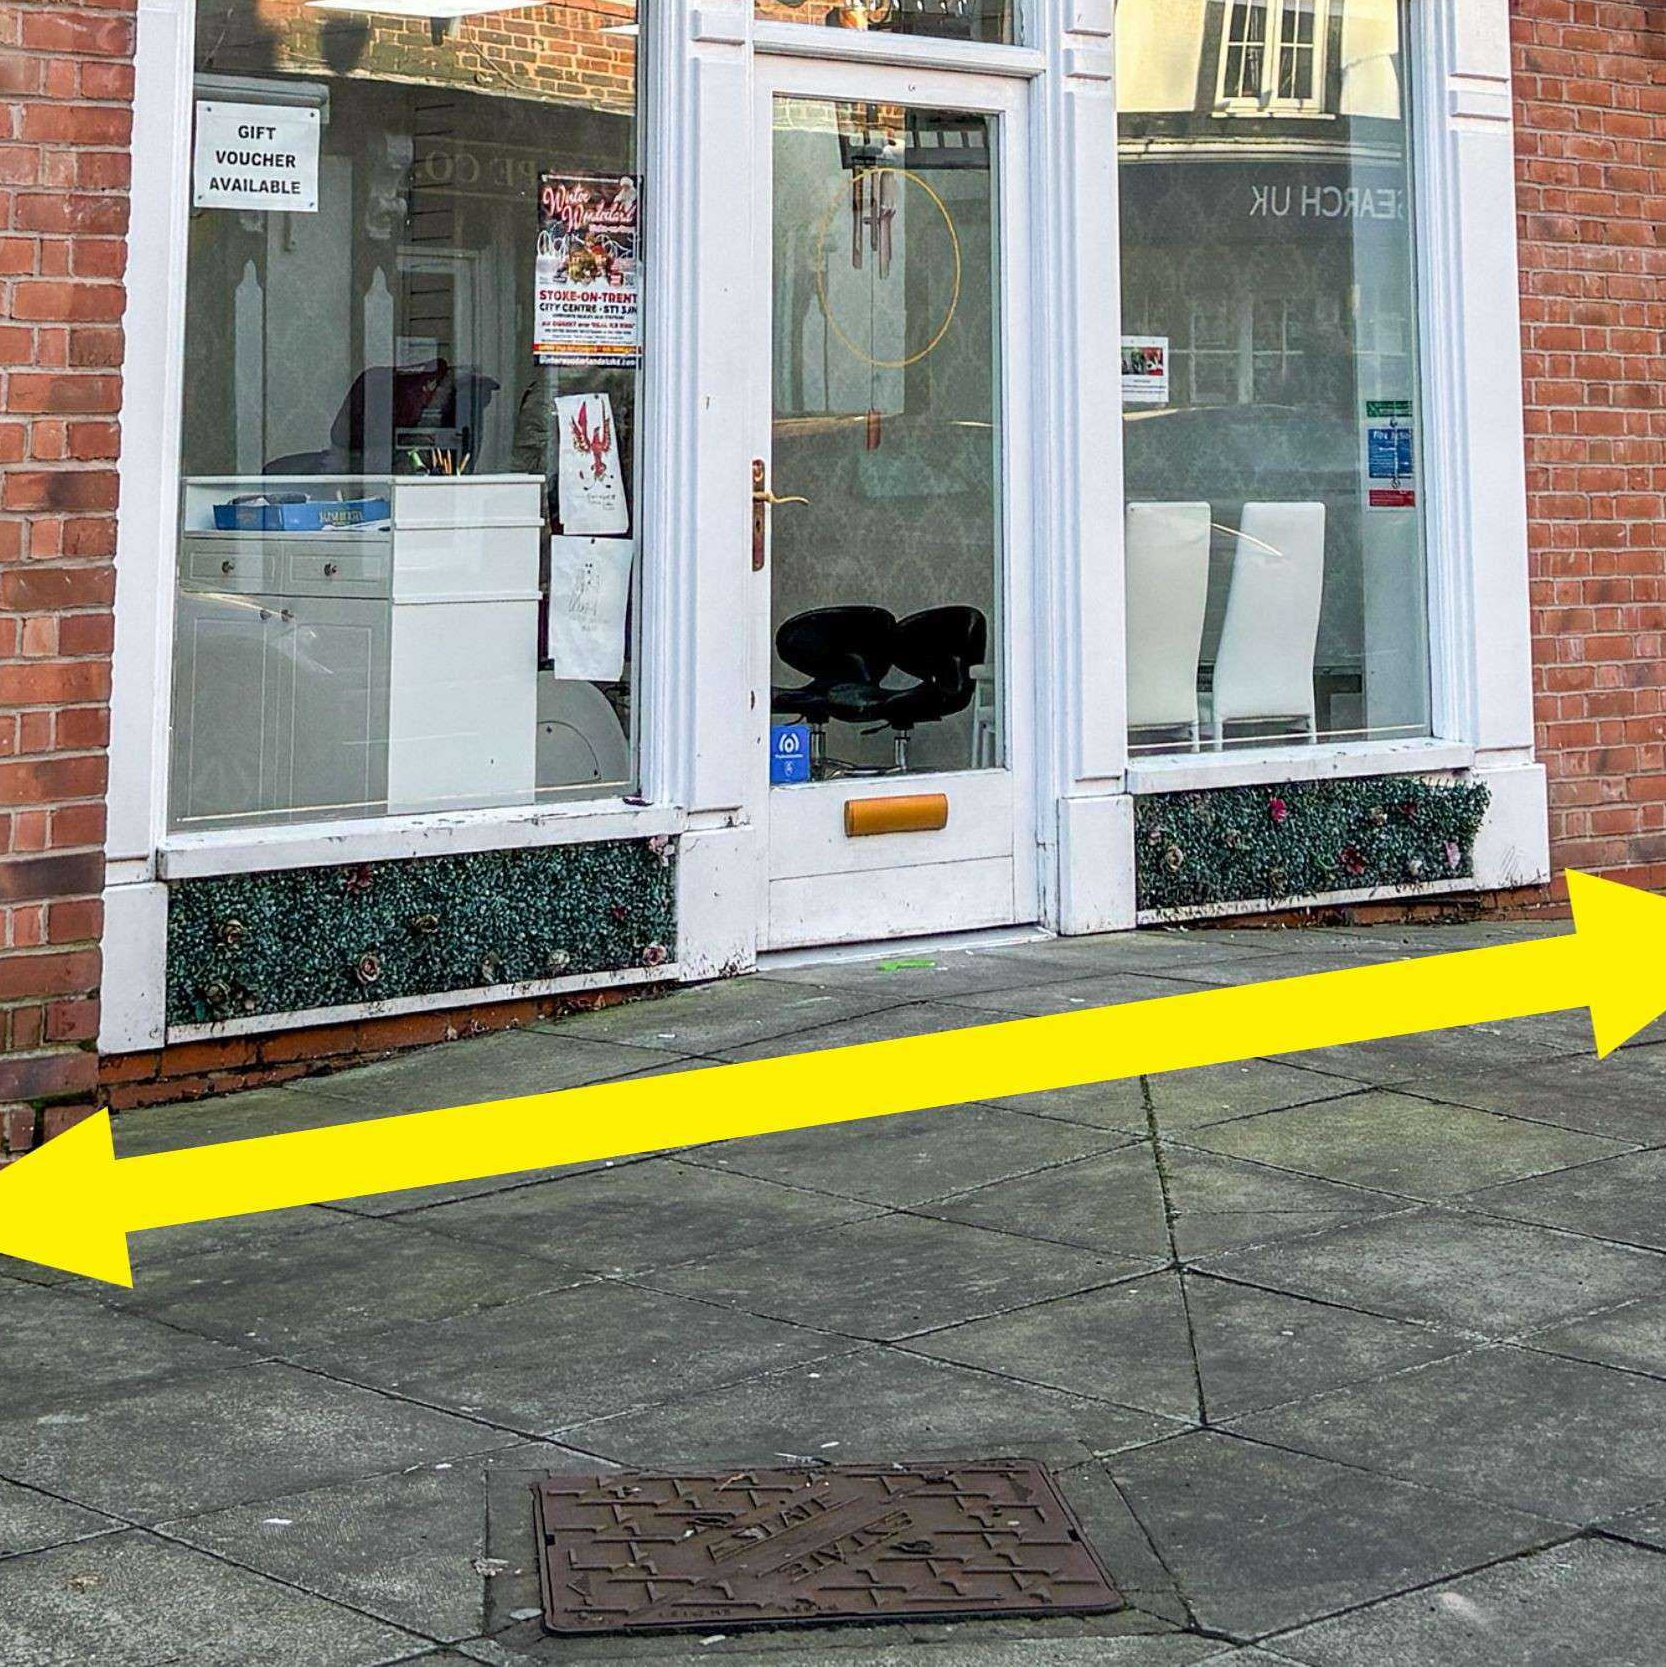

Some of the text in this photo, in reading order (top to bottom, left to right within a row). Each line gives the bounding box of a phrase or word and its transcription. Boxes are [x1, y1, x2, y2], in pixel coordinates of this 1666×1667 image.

[237, 124, 276, 142] GIFT
[215, 151, 297, 170] VOUCHER
[208, 177, 301, 196] AVAILABLE
[539, 290, 638, 304] STOKE-ON-TRENT
[539, 302, 560, 313] CITY
[562, 303, 597, 314] CENTRE
